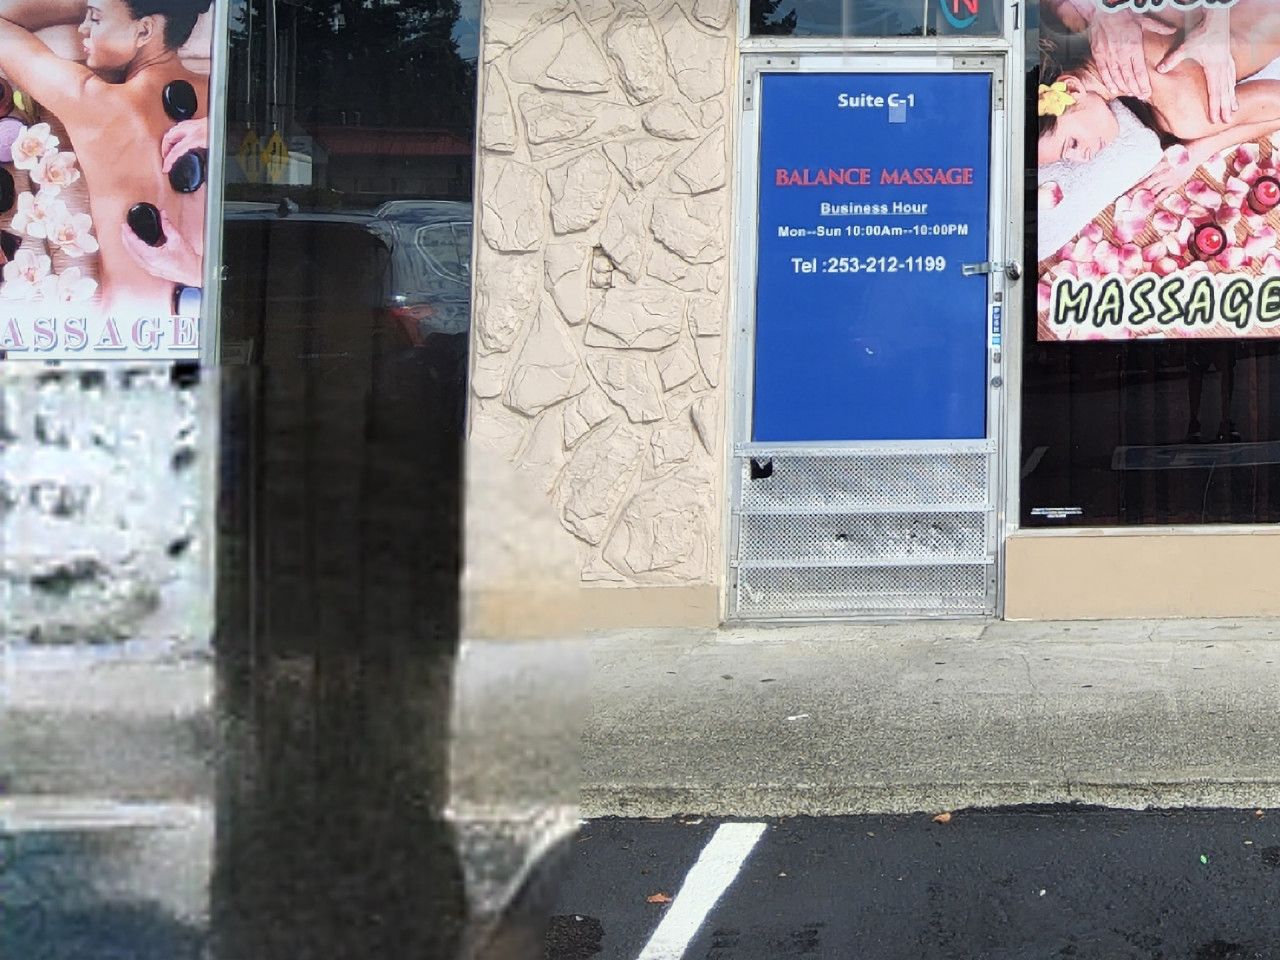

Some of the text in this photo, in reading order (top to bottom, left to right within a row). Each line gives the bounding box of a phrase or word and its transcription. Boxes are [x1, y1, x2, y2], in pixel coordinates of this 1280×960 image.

[837, 93, 915, 107] Suite C-1
[775, 167, 974, 186] BALANCE MASSAGE
[820, 202, 928, 215] Business Hour
[791, 257, 817, 273] Tel
